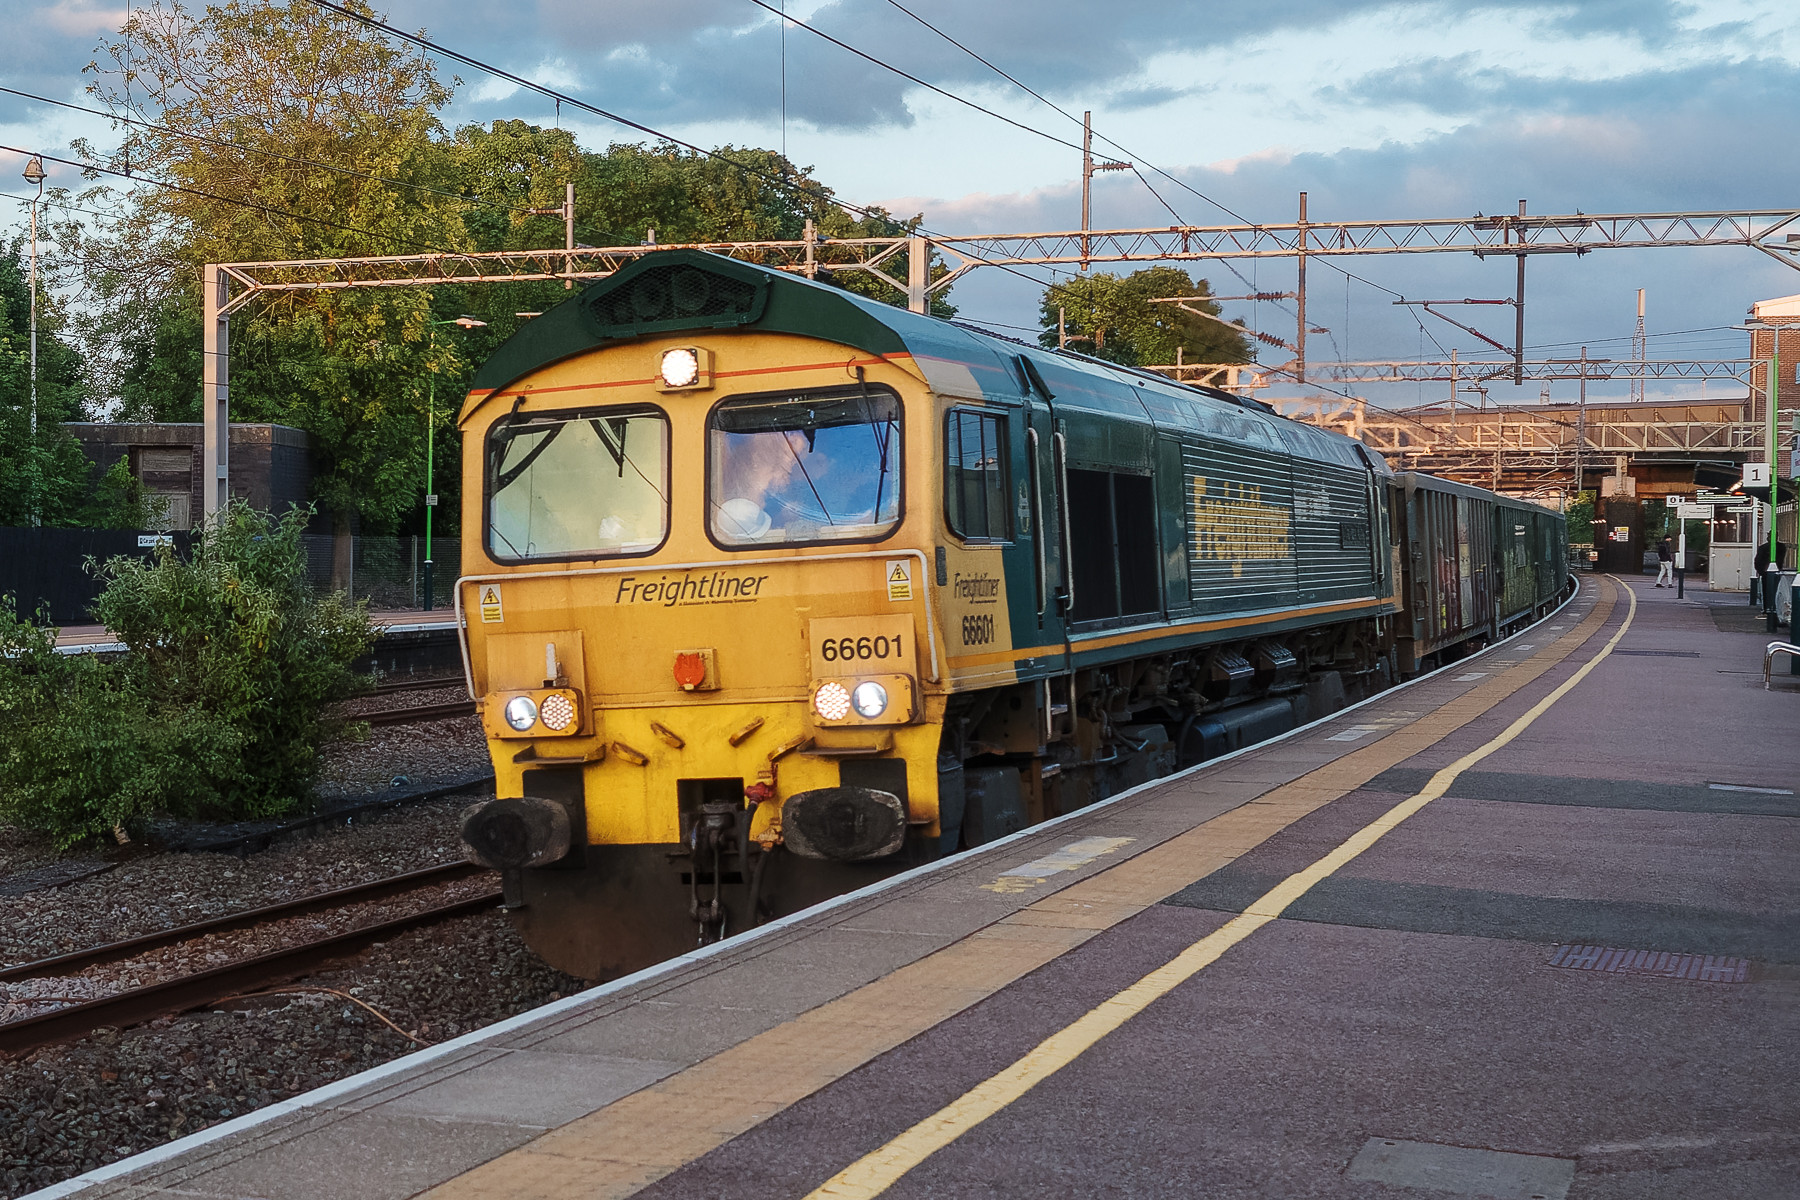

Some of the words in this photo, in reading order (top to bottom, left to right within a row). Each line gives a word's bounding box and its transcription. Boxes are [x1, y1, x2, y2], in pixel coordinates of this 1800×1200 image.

[1751, 468, 1761, 481] 1
[615, 571, 769, 607] Freightliner
[962, 614, 995, 646] 66601
[822, 634, 902, 662] 66601
